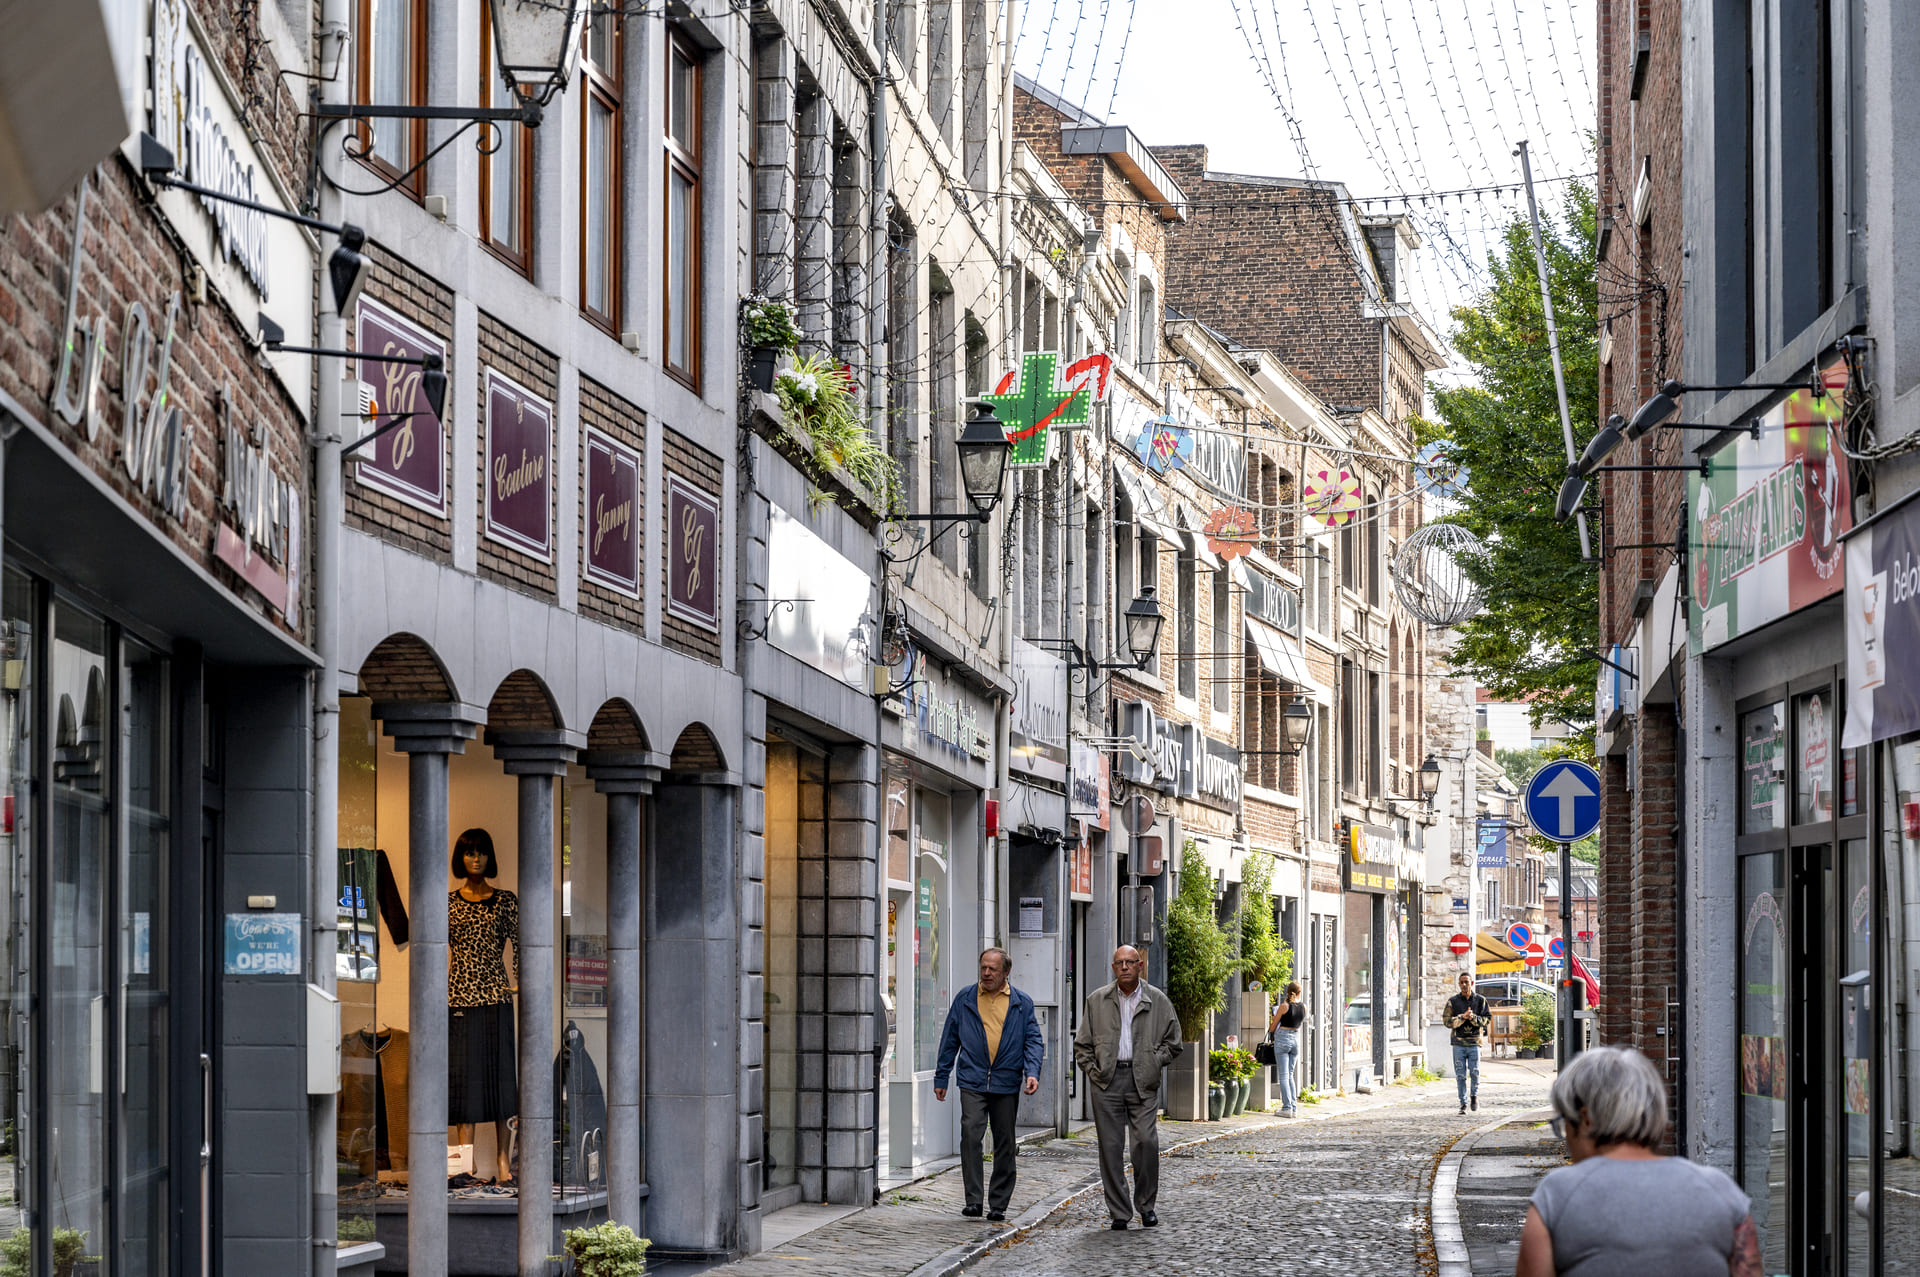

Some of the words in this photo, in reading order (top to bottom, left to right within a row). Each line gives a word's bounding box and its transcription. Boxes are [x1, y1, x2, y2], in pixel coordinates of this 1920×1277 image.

[185, 44, 270, 303] Hoegaarden
[494, 448, 544, 501] Couture
[594, 493, 631, 556] Janny
[1263, 575, 1289, 629] DÉCO
[928, 680, 958, 746] Pharma
[958, 698, 977, 757] Santé
[1140, 699, 1183, 799] Daisy
[1191, 720, 1240, 803] Flowers
[236, 952, 292, 969] OPEN
[249, 941, 280, 950] WE'RE
